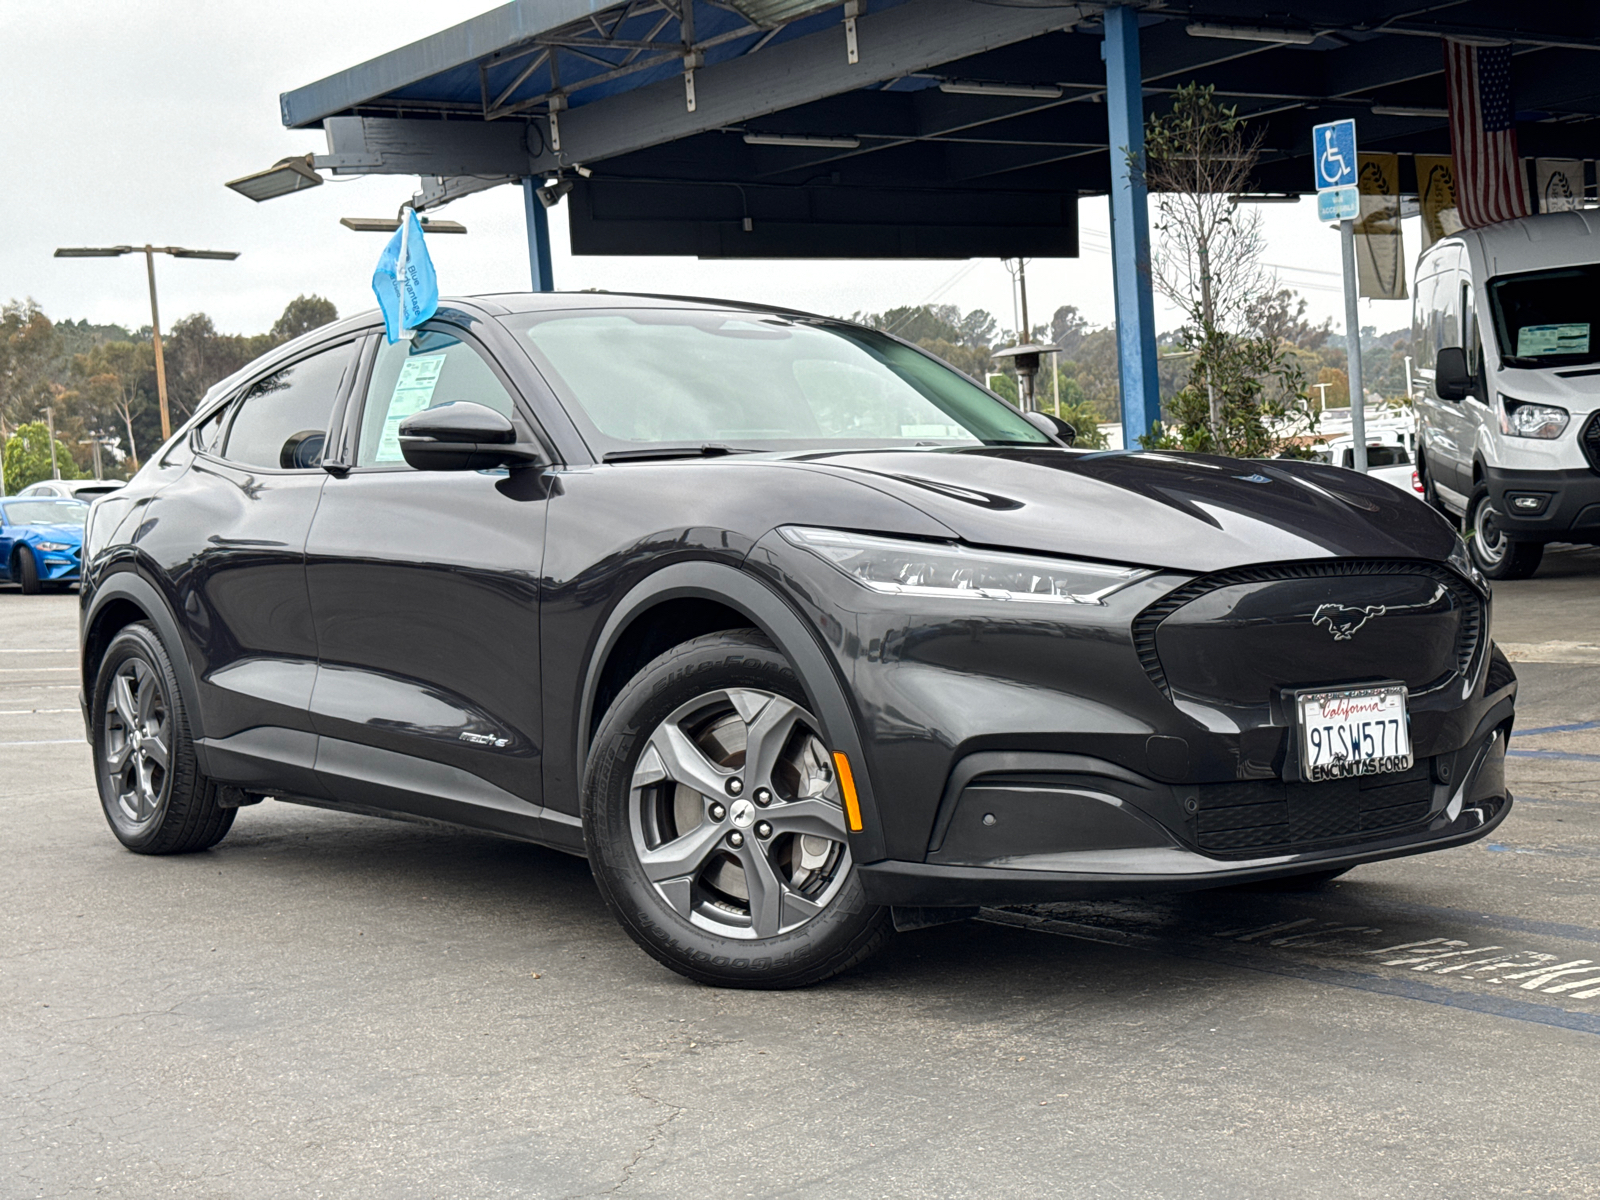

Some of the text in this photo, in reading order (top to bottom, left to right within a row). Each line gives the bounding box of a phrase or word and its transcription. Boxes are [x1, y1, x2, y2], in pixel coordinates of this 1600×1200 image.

[404, 270, 421, 317] dvantage
[407, 264, 420, 286] Blue
[1322, 699, 1386, 721] California
[1310, 718, 1399, 766] 9TSW577
[1311, 755, 1410, 782] ENCINITAS FORD
[636, 909, 812, 972] BFGoodrich
